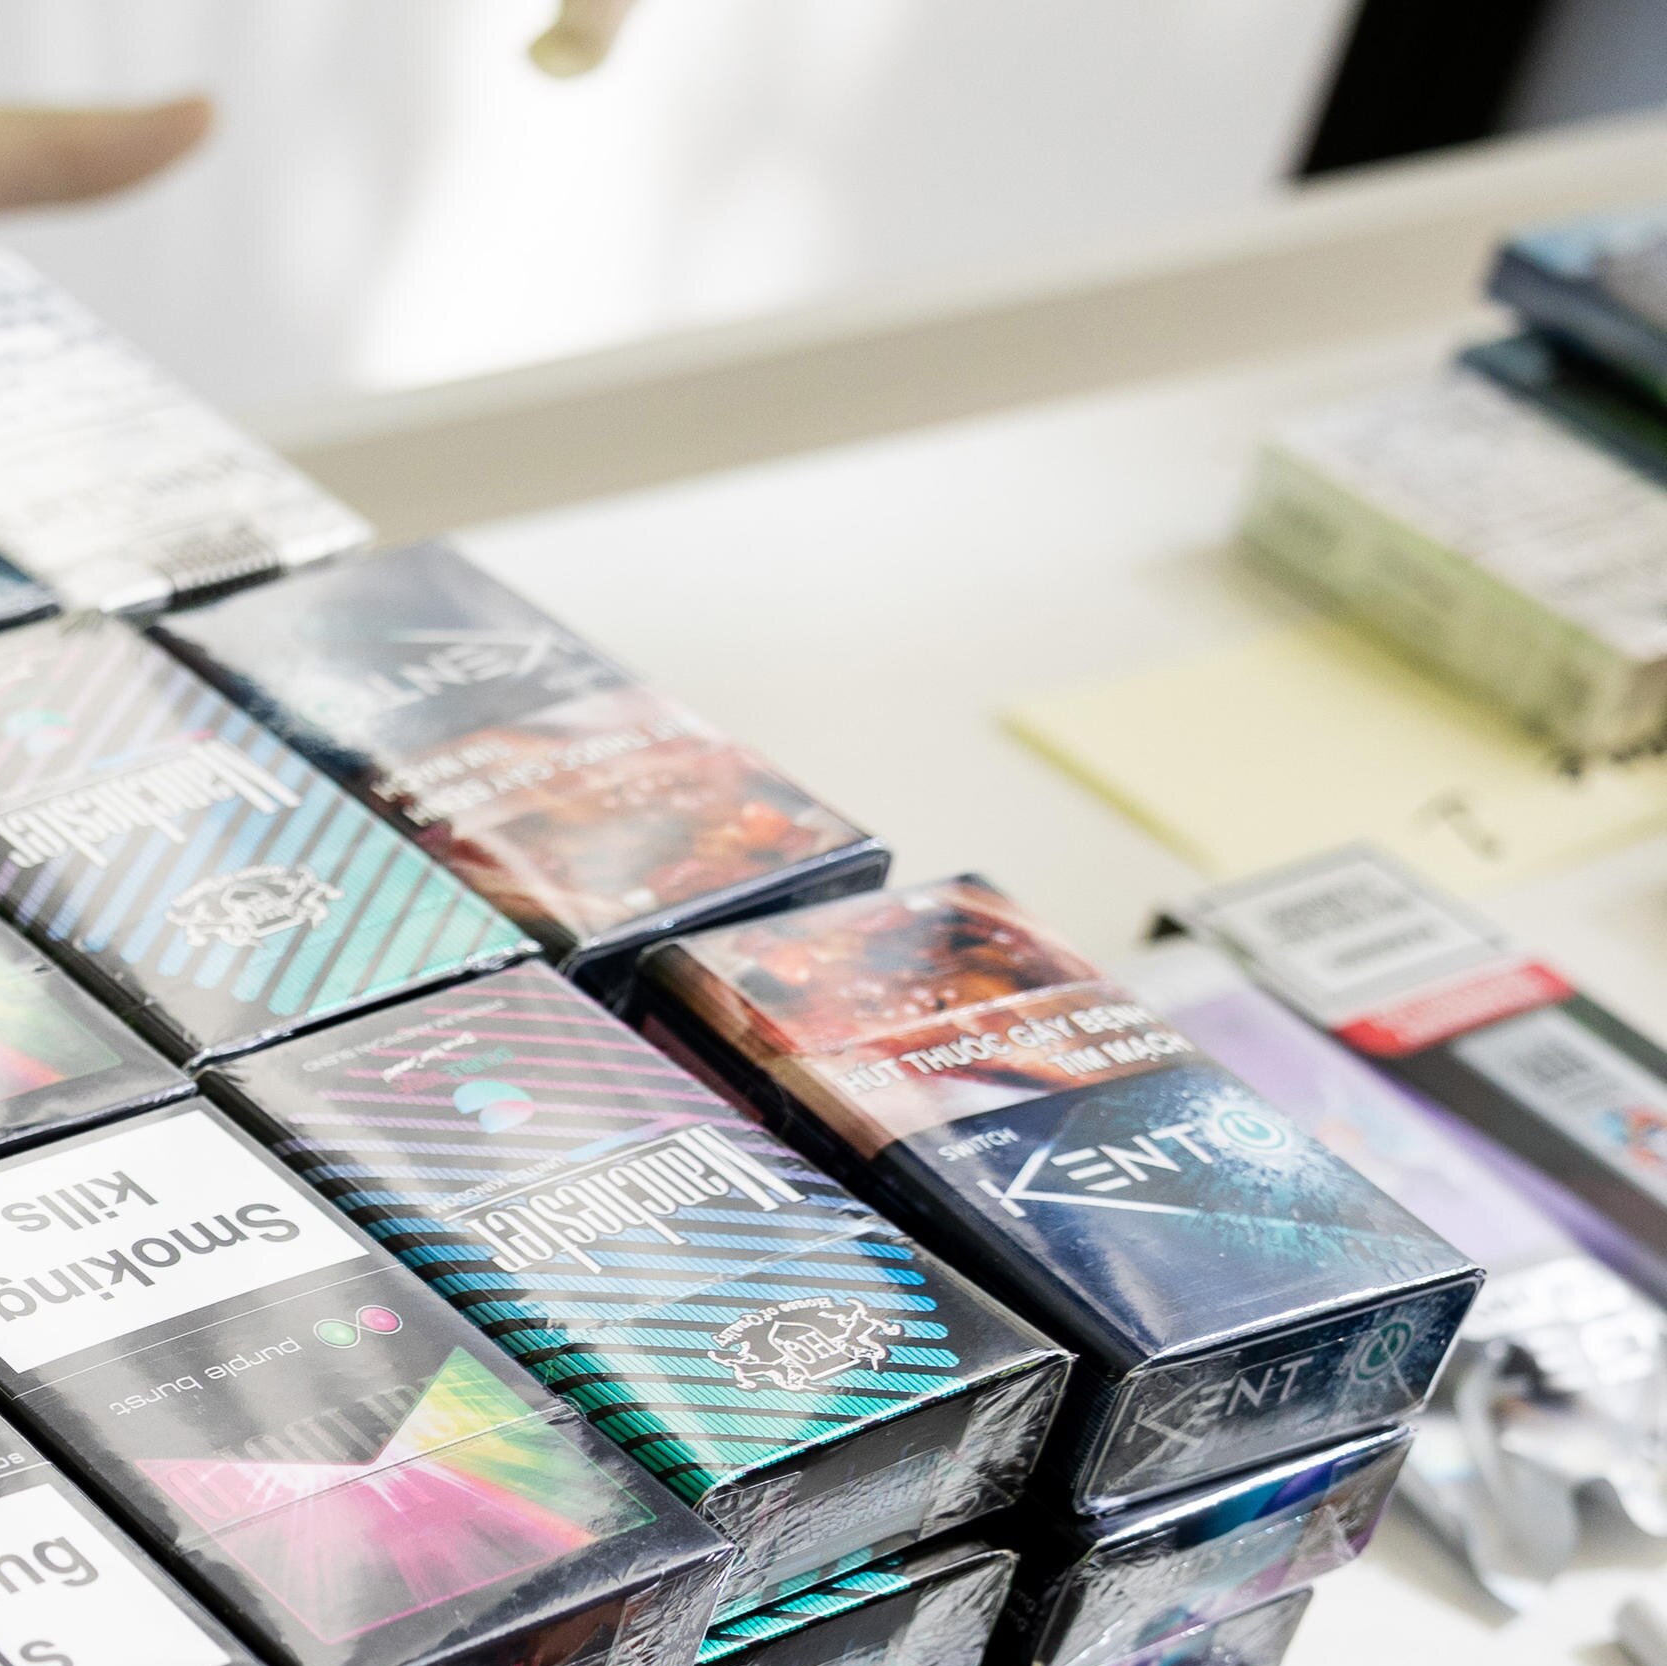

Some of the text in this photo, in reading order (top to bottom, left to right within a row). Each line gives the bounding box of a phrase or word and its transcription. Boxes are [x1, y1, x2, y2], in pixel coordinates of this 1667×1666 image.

[839, 1063, 906, 1097] HÚT
[1008, 1014, 1078, 1051] GÂY
[1047, 1029, 1196, 1079] TIM MẠCH
[506, 1158, 568, 1184] UNITED
[937, 1125, 1021, 1163] SWITCH
[976, 1122, 1215, 1219] KENT
[5, 1168, 161, 1237] kills
[465, 1122, 806, 1275] Manchester
[778, 1296, 835, 1313] House
[108, 1337, 305, 1419] purple burst
[784, 1331, 841, 1366] HQ
